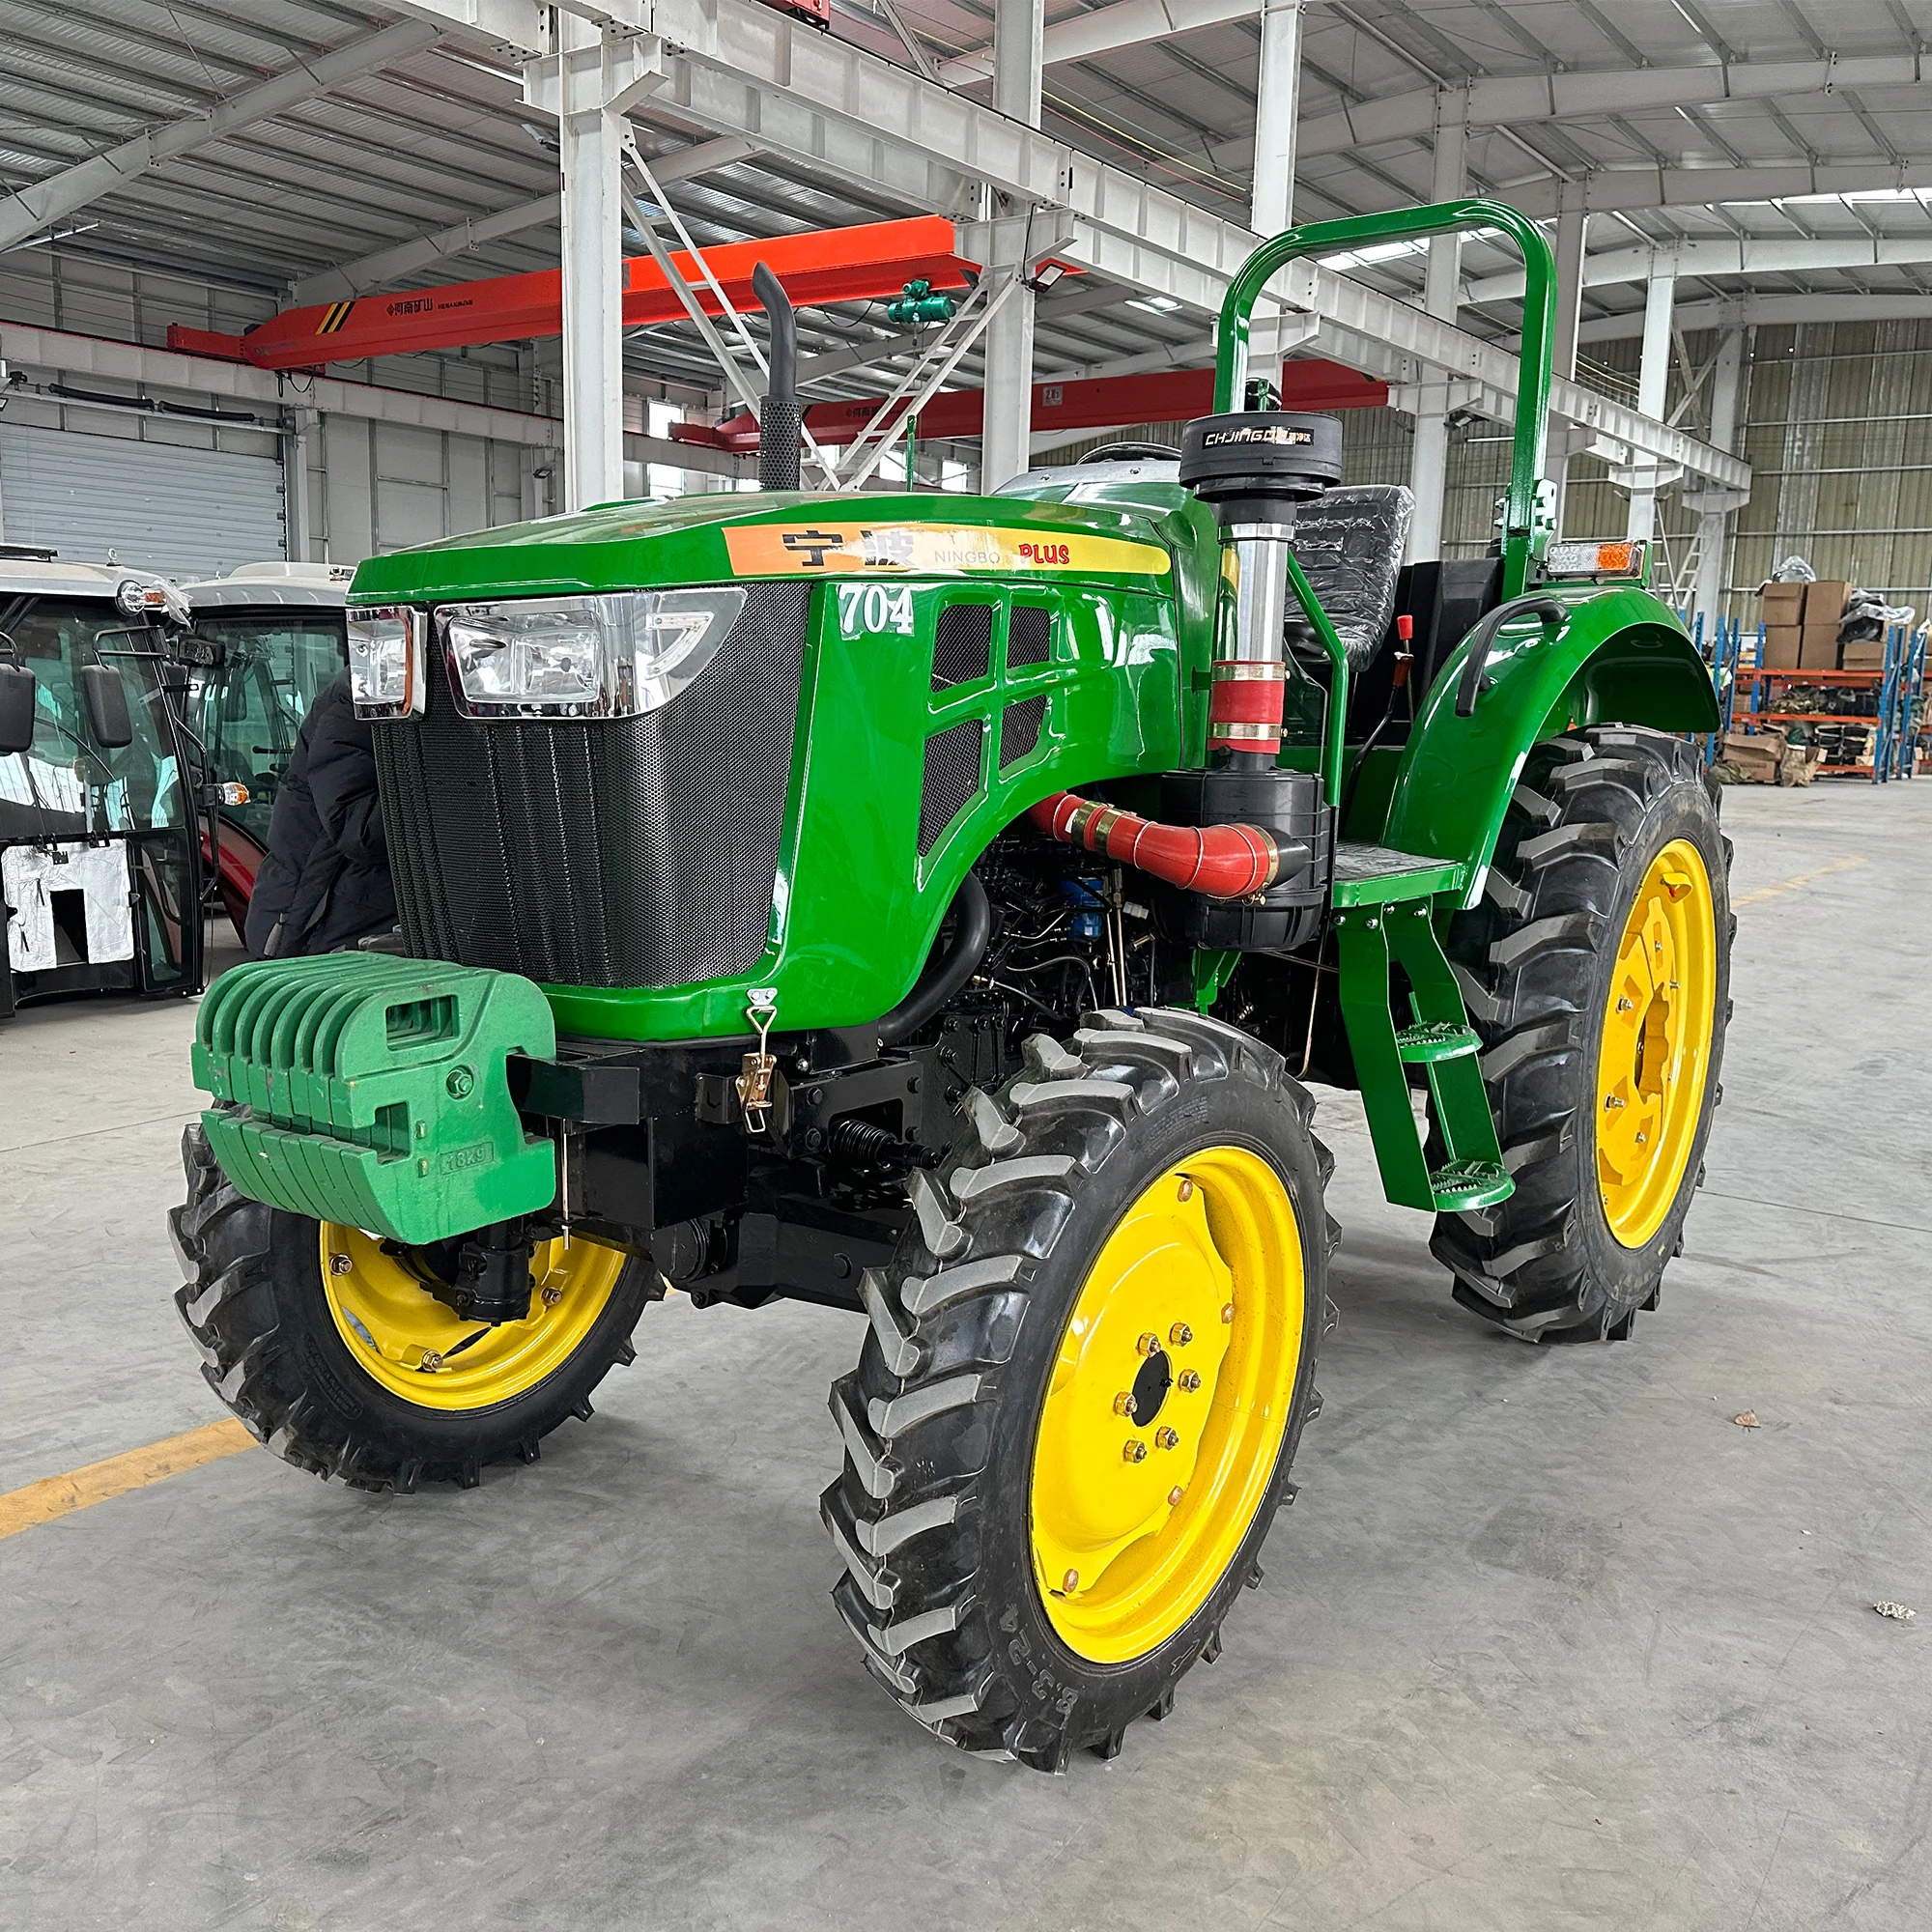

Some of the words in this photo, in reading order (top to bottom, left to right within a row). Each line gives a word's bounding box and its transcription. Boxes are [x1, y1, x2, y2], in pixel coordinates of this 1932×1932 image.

[394, 298, 433, 316] 河南矿山
[781, 529, 916, 567] 宁波
[934, 550, 1000, 564] NINGBO
[1018, 543, 1070, 564] PLUS
[838, 583, 914, 634] 704
[999, 1604, 1079, 1716] 8.3-24
